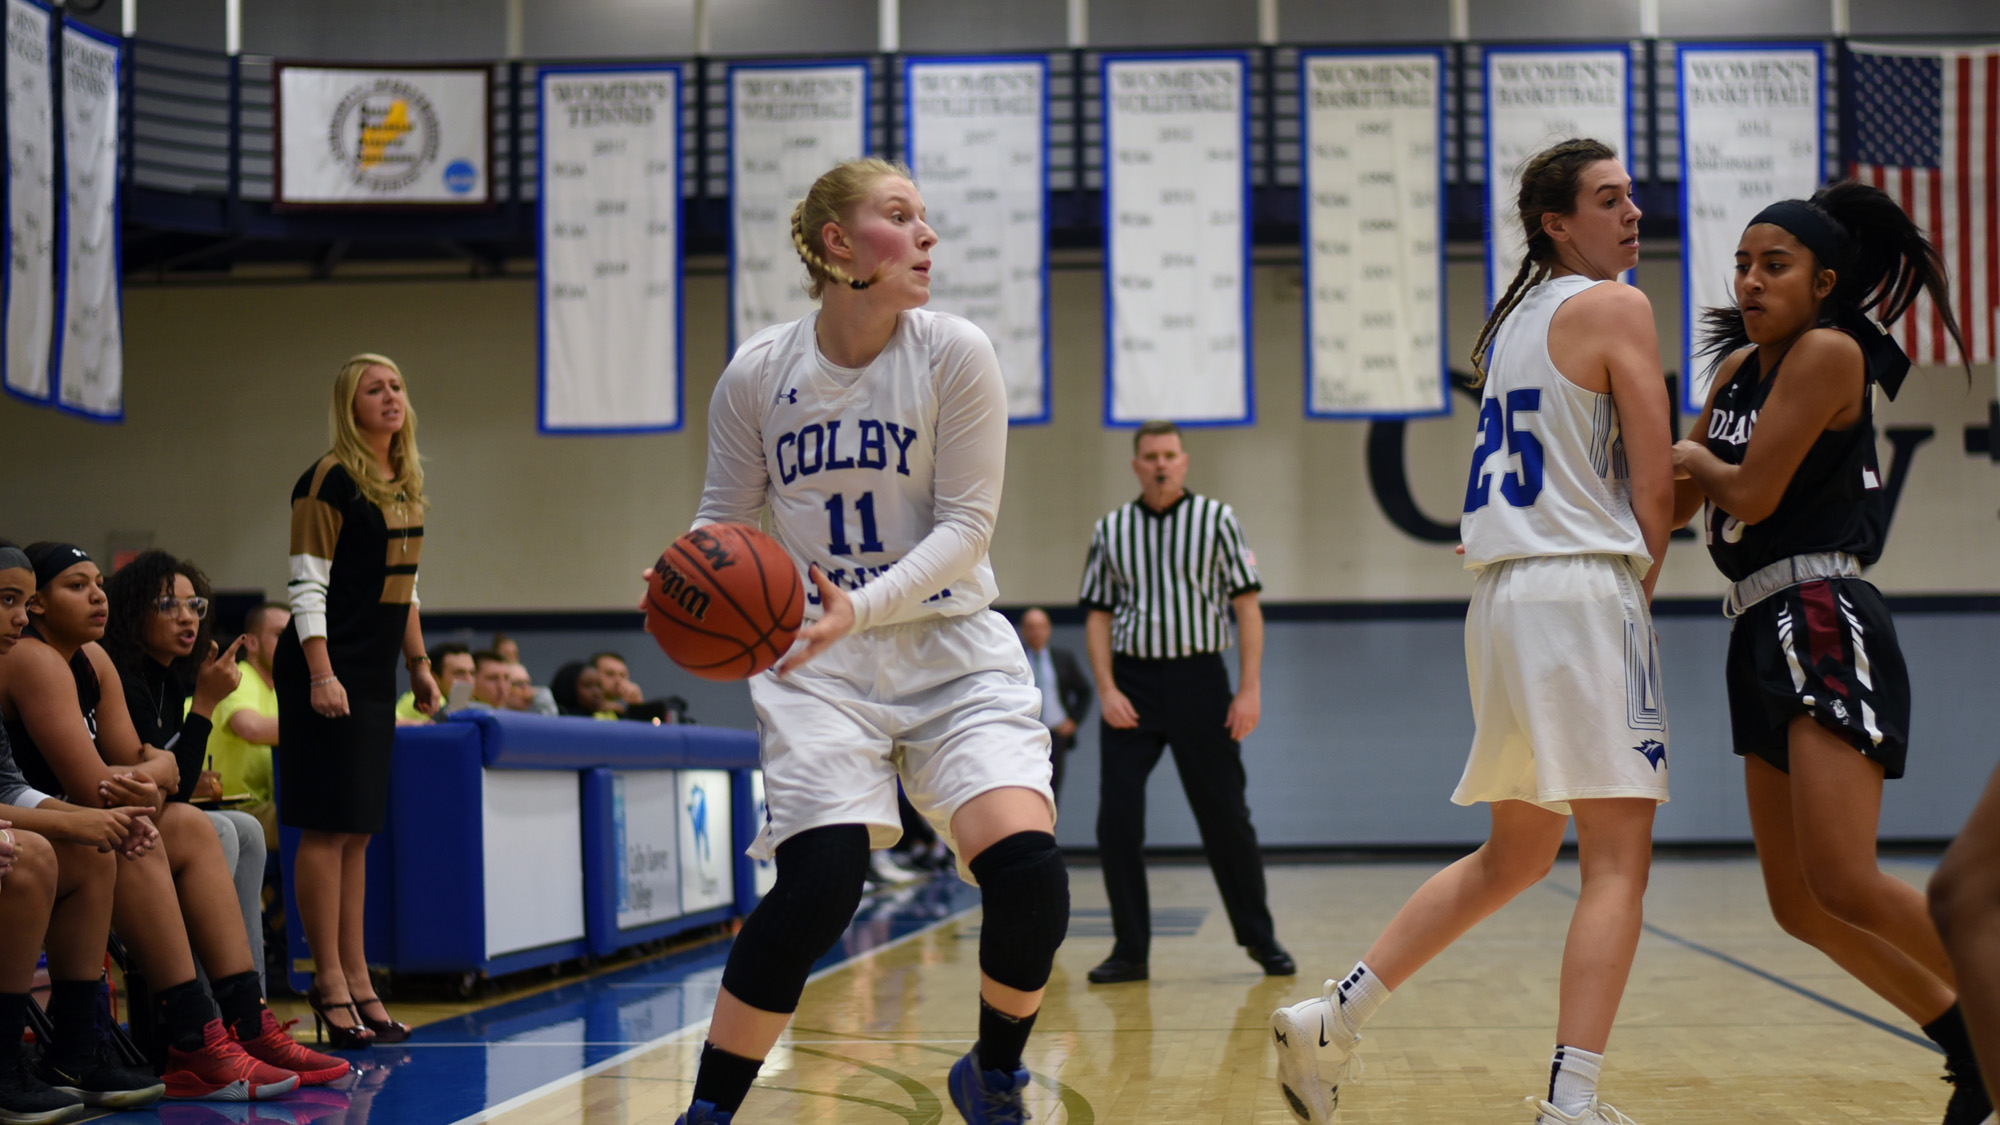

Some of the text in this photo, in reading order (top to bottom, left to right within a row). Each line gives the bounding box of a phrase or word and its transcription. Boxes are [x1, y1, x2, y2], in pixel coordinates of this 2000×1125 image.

[777, 419, 917, 485] COLBY
[1463, 387, 1544, 514] 25
[825, 491, 884, 555] 11
[654, 555, 712, 623] Wilso
